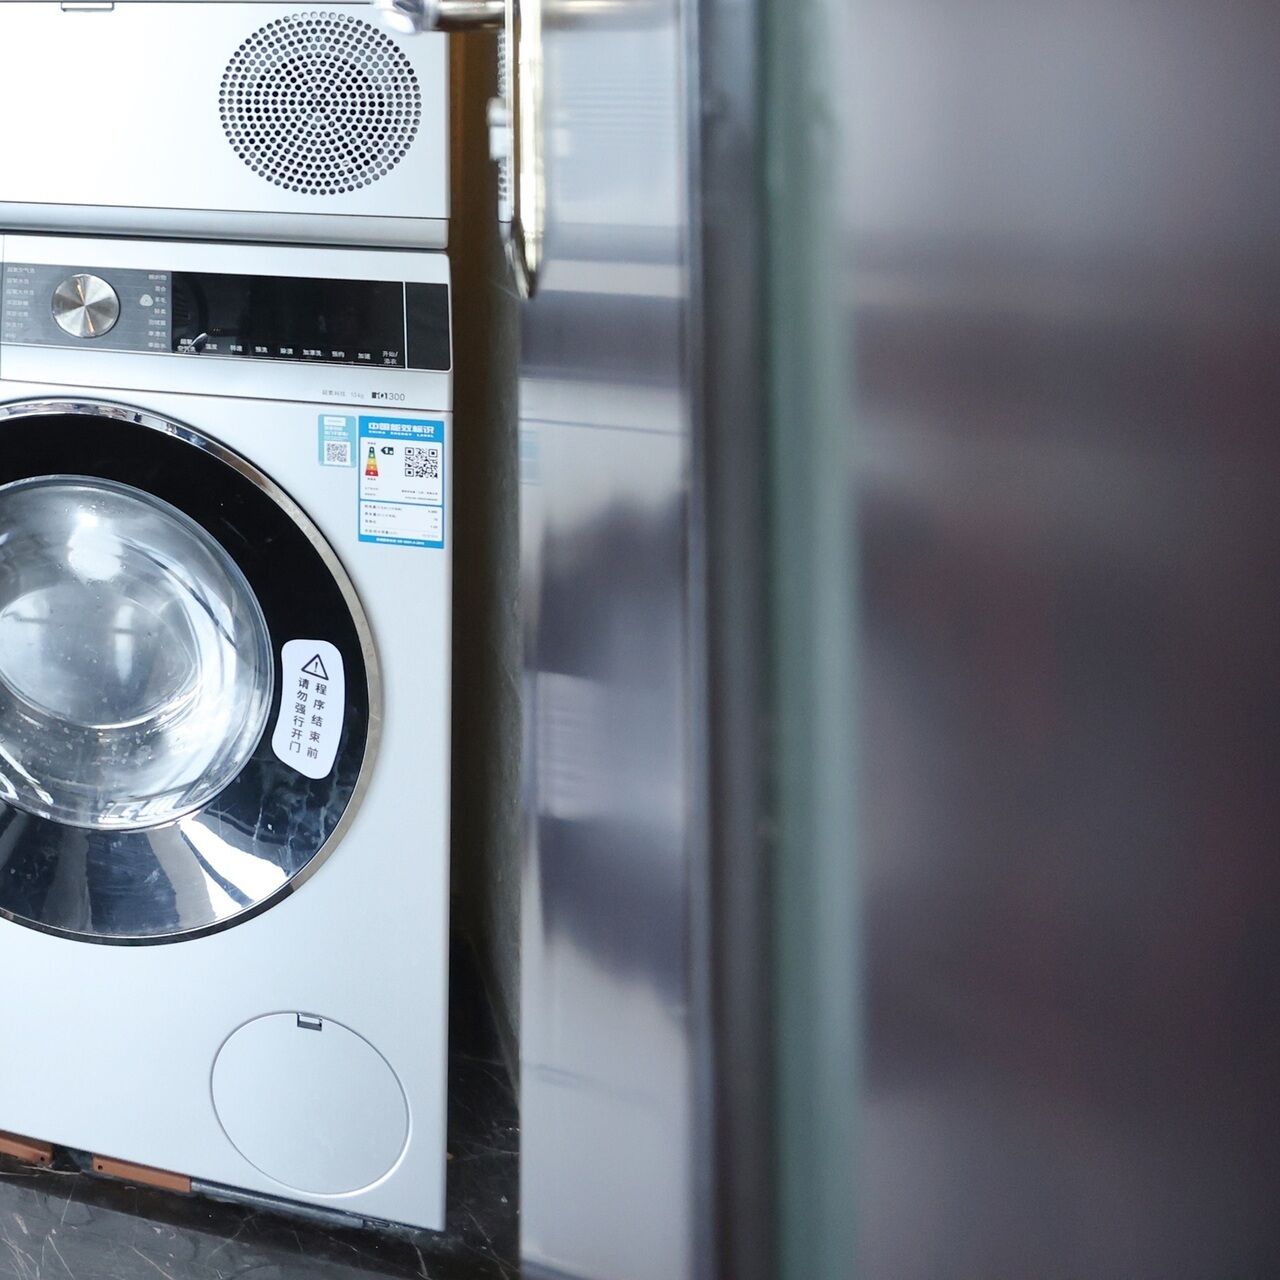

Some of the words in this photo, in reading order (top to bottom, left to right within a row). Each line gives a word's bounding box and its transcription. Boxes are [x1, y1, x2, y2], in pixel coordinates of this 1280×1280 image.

[367, 422, 435, 434] 中国能效标识
[289, 677, 309, 753] 请勿强行开门
[306, 682, 327, 759] 程序结束前
